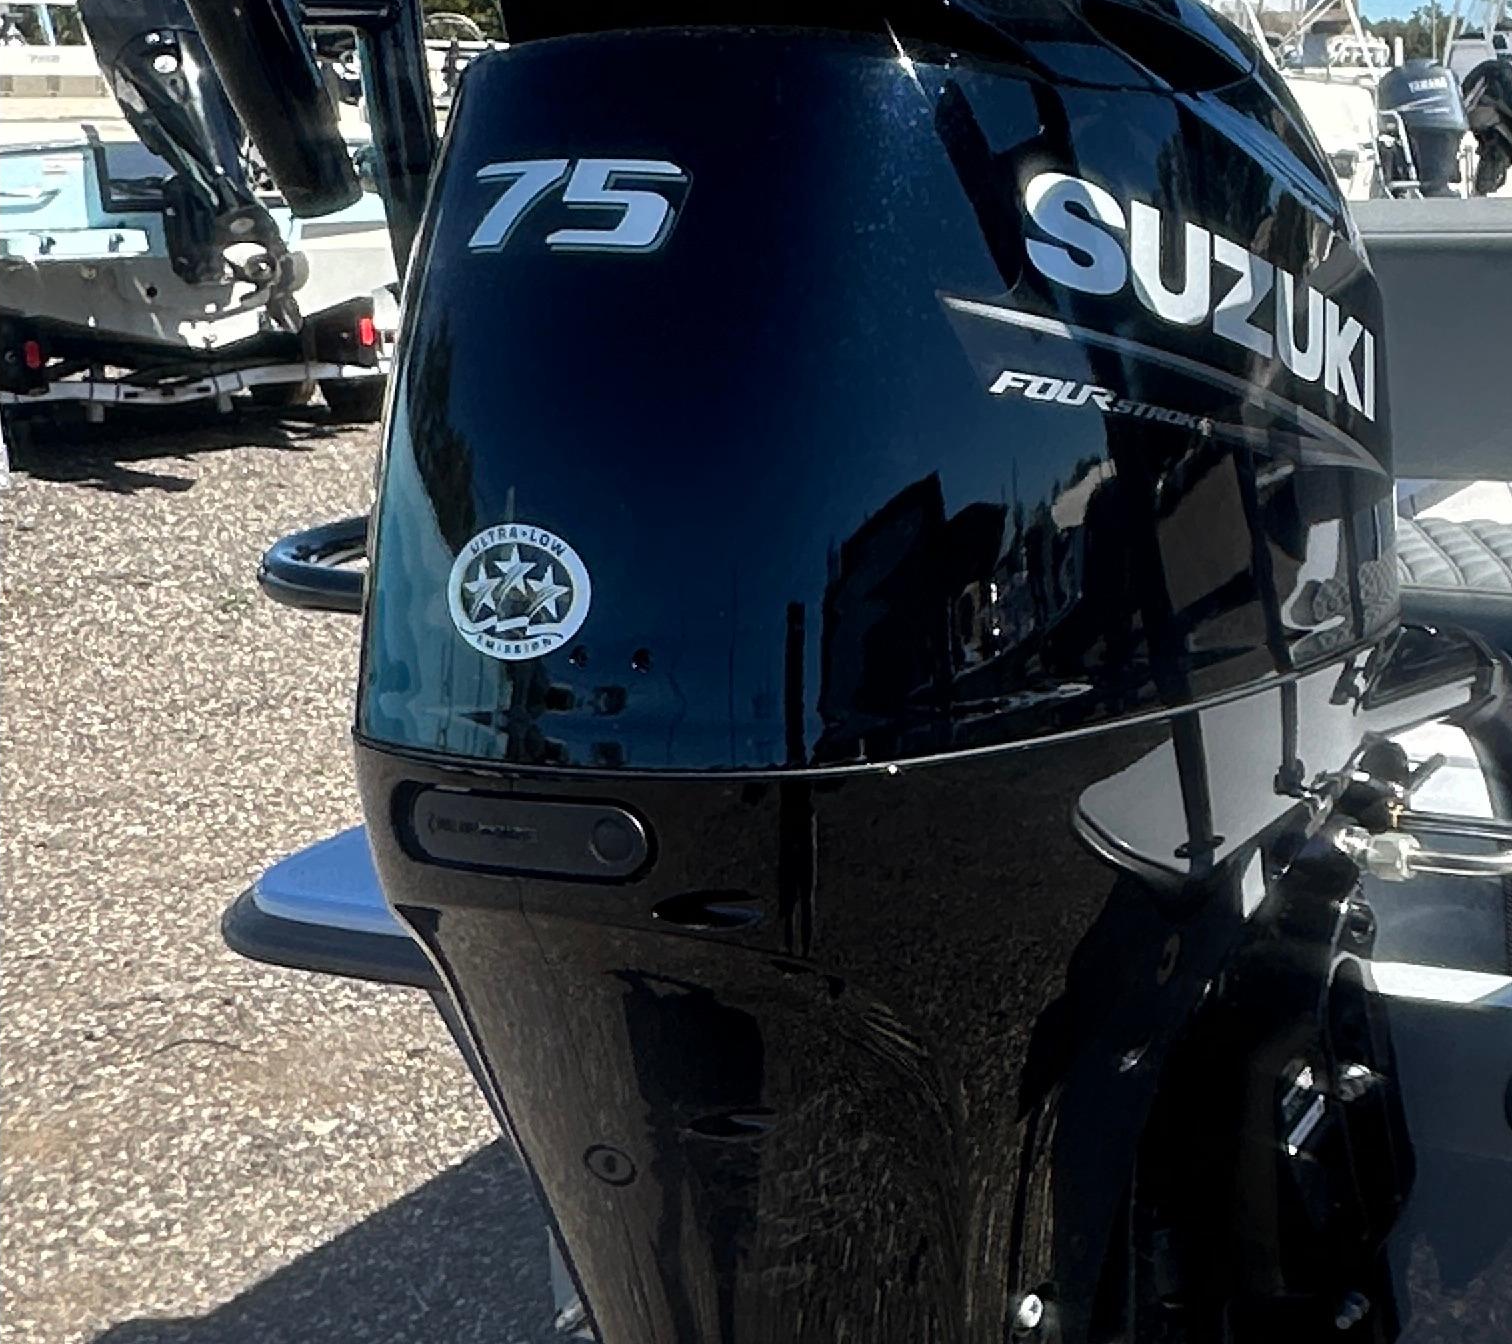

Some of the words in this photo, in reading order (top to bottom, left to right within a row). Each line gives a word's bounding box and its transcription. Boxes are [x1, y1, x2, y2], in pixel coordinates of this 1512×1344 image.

[468, 158, 688, 254] 75
[1025, 171, 1376, 423] SUZUKI
[989, 370, 1117, 412] FOUR
